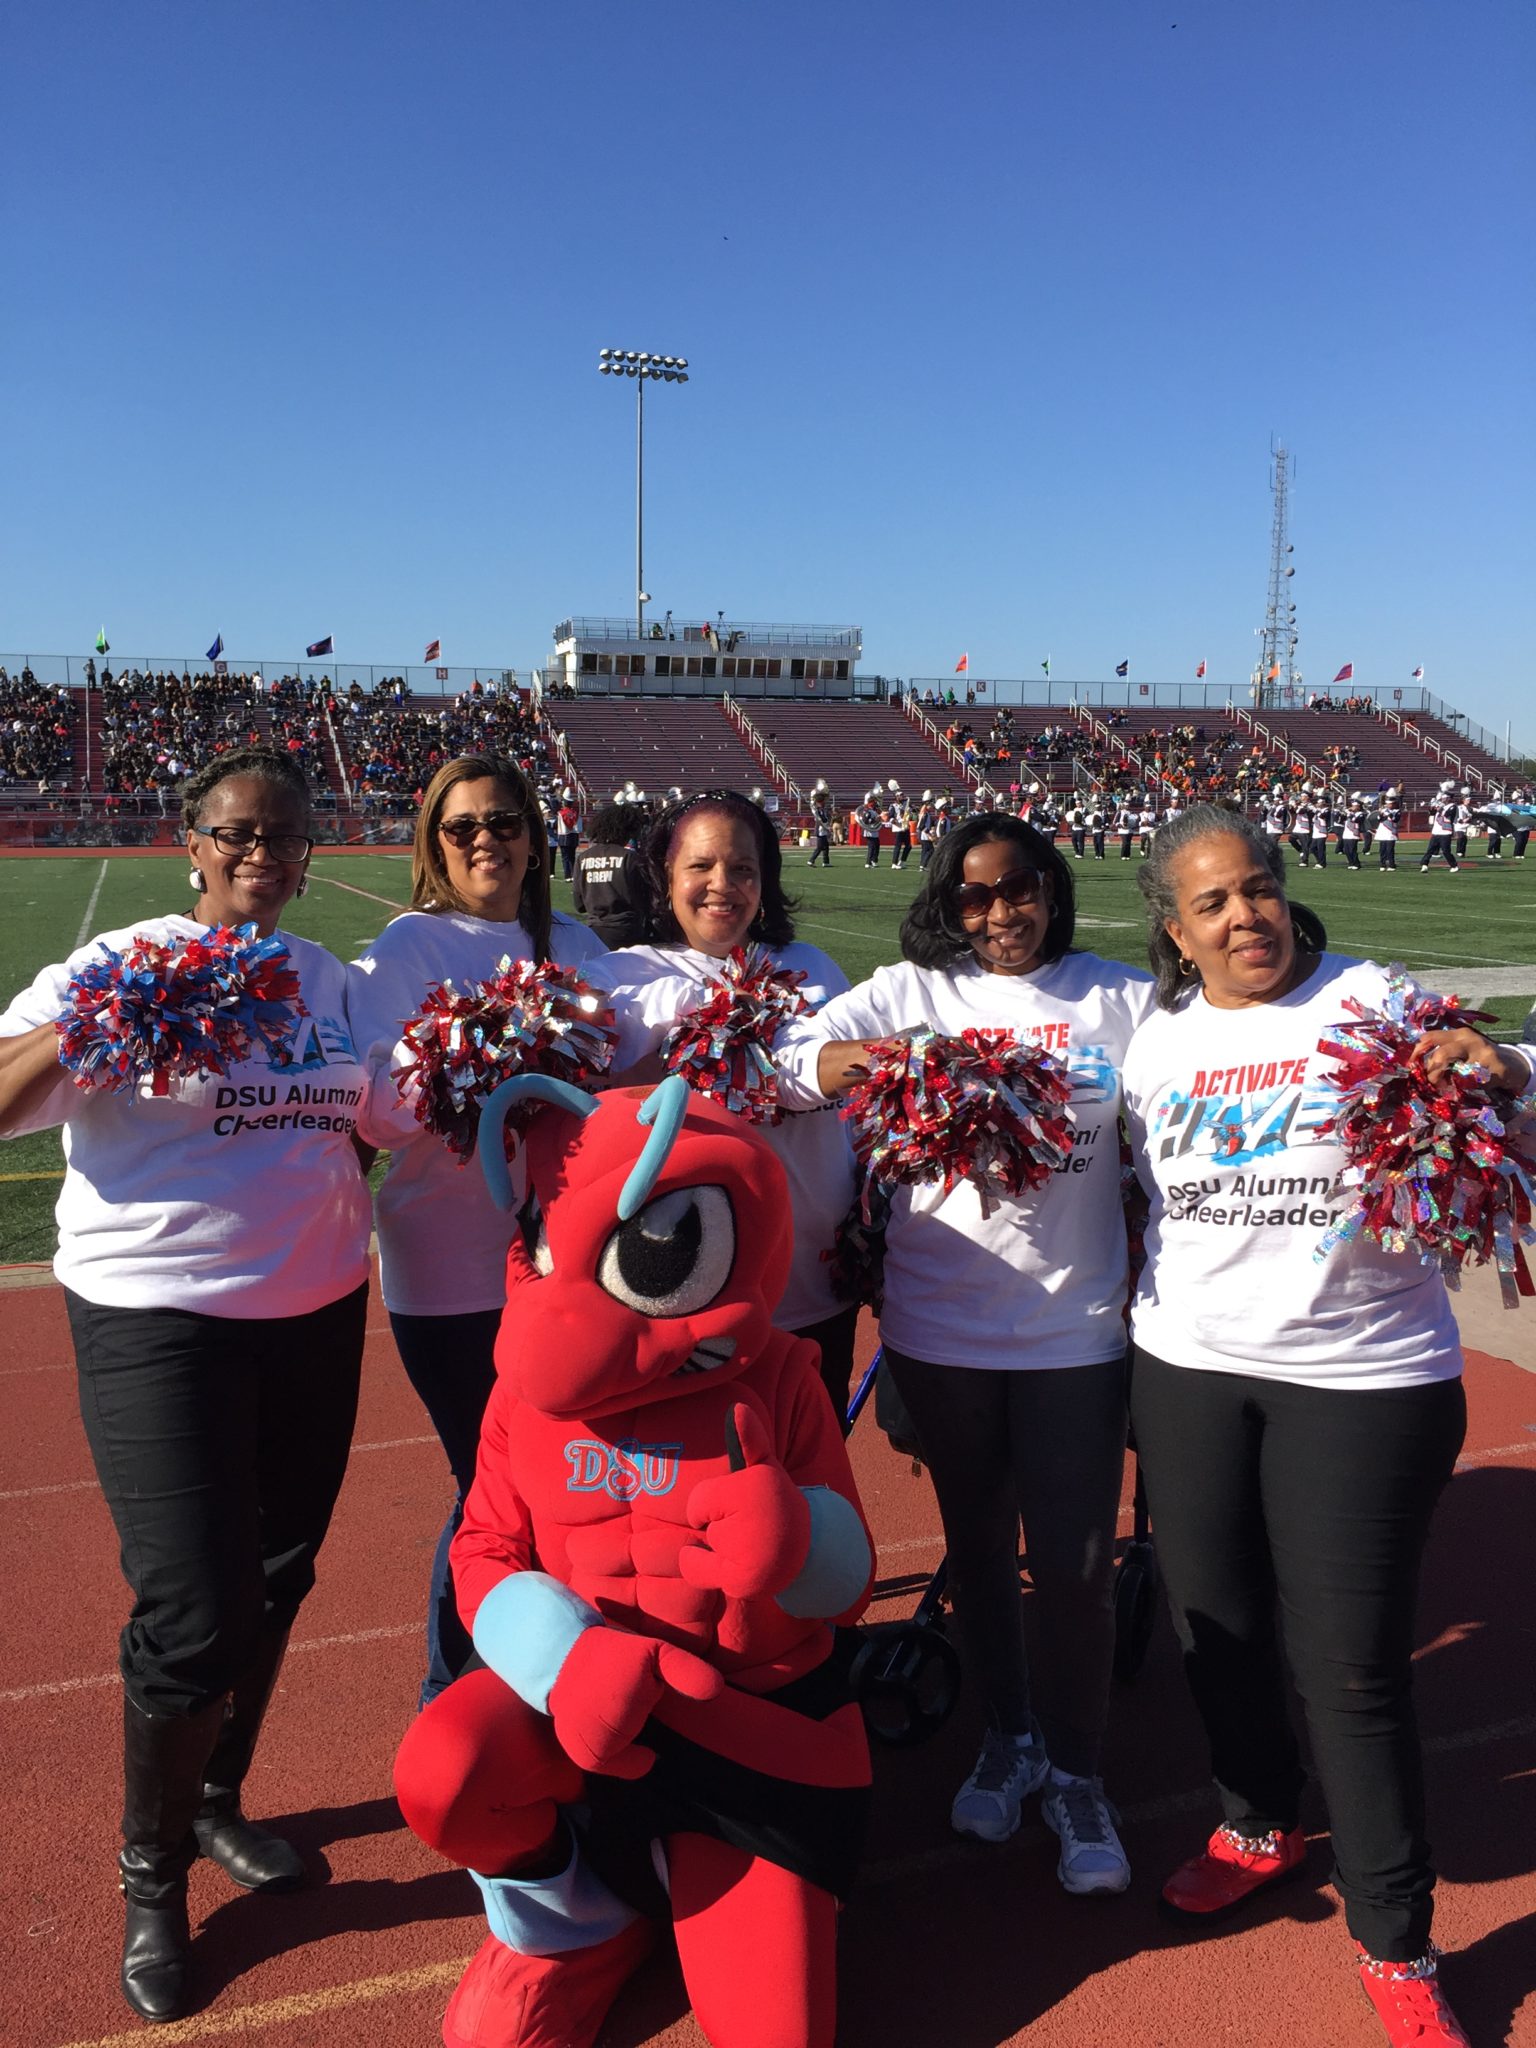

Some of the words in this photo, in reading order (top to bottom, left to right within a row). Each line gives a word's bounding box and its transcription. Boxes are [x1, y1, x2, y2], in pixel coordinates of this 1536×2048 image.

[586, 870, 613, 884] CREW
[1189, 1057, 1309, 1100] ACTIVATE
[216, 1086, 277, 1109] DSU
[284, 1083, 365, 1106] Alumni
[1168, 1178, 1221, 1202] DSU
[564, 1437, 684, 1502] DSU
